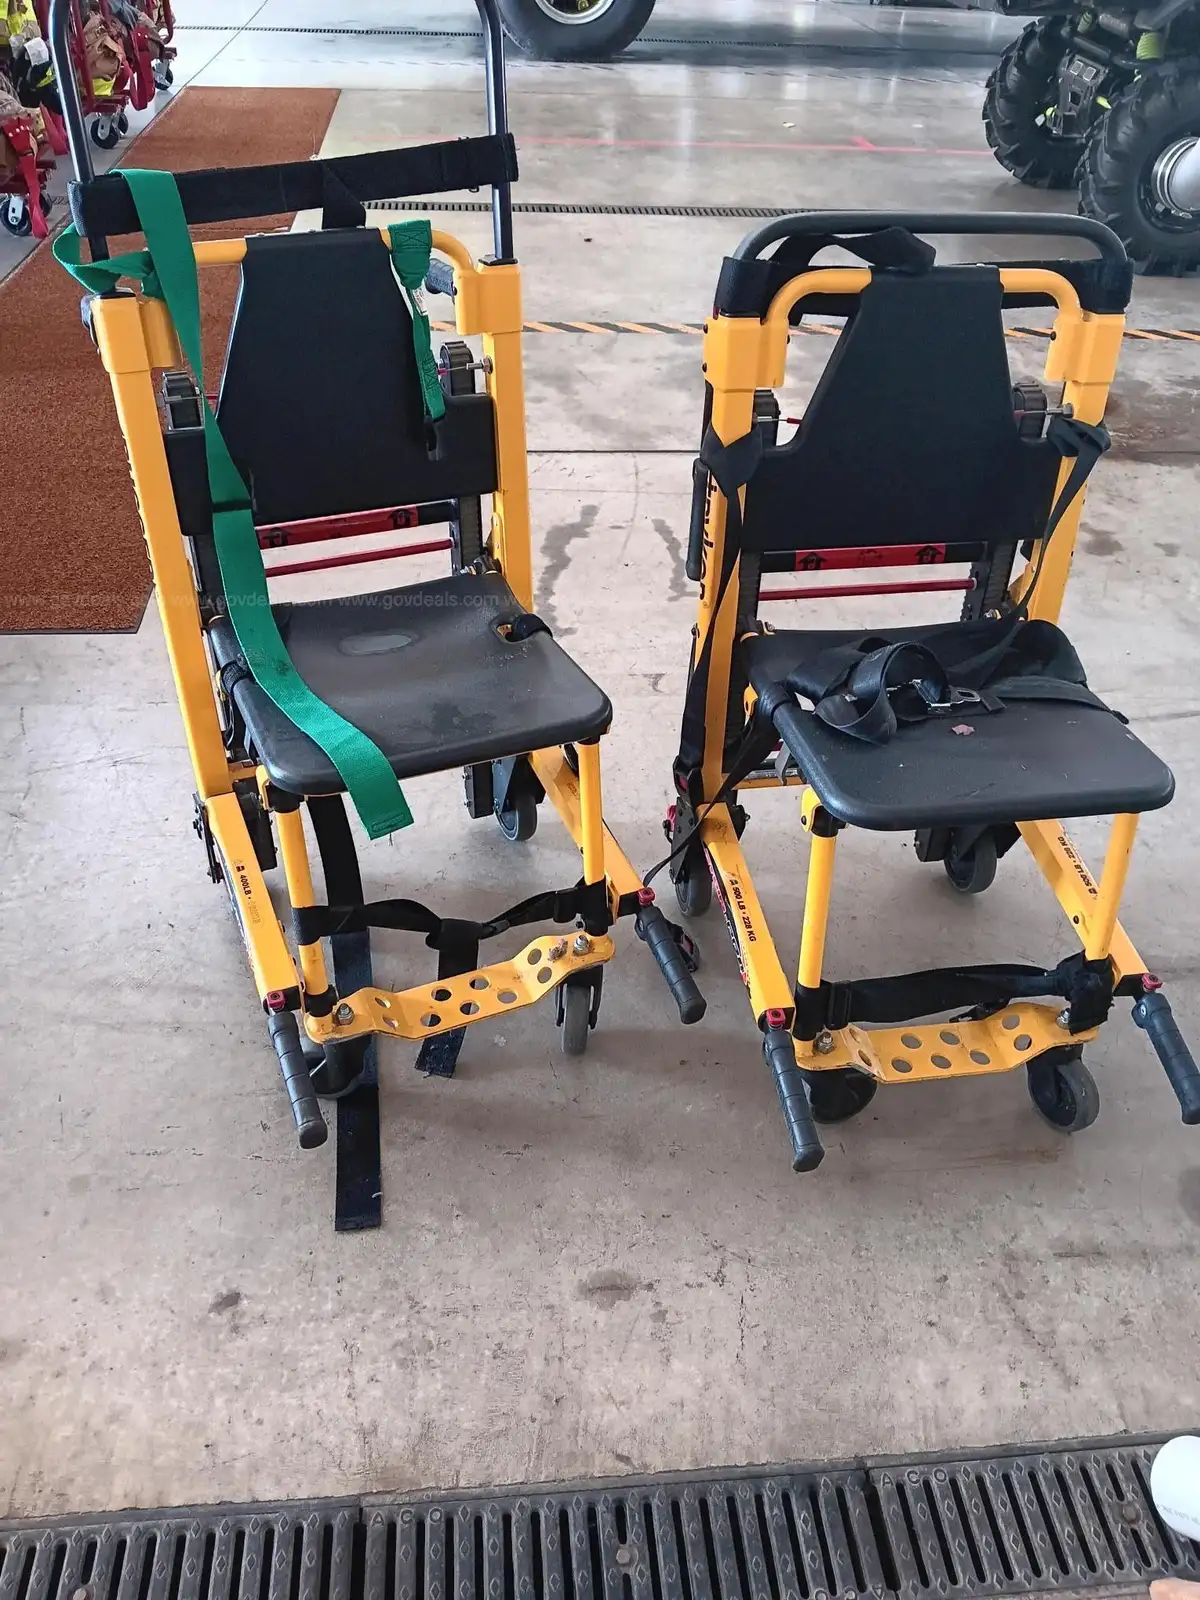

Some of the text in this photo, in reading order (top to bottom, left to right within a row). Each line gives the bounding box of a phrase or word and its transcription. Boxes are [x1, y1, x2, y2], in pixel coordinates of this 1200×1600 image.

[737, 901, 746, 910] LB
[747, 930, 756, 941] KG
[879, 1467, 948, 1489] ACO
[370, 1507, 444, 1526] ACO
